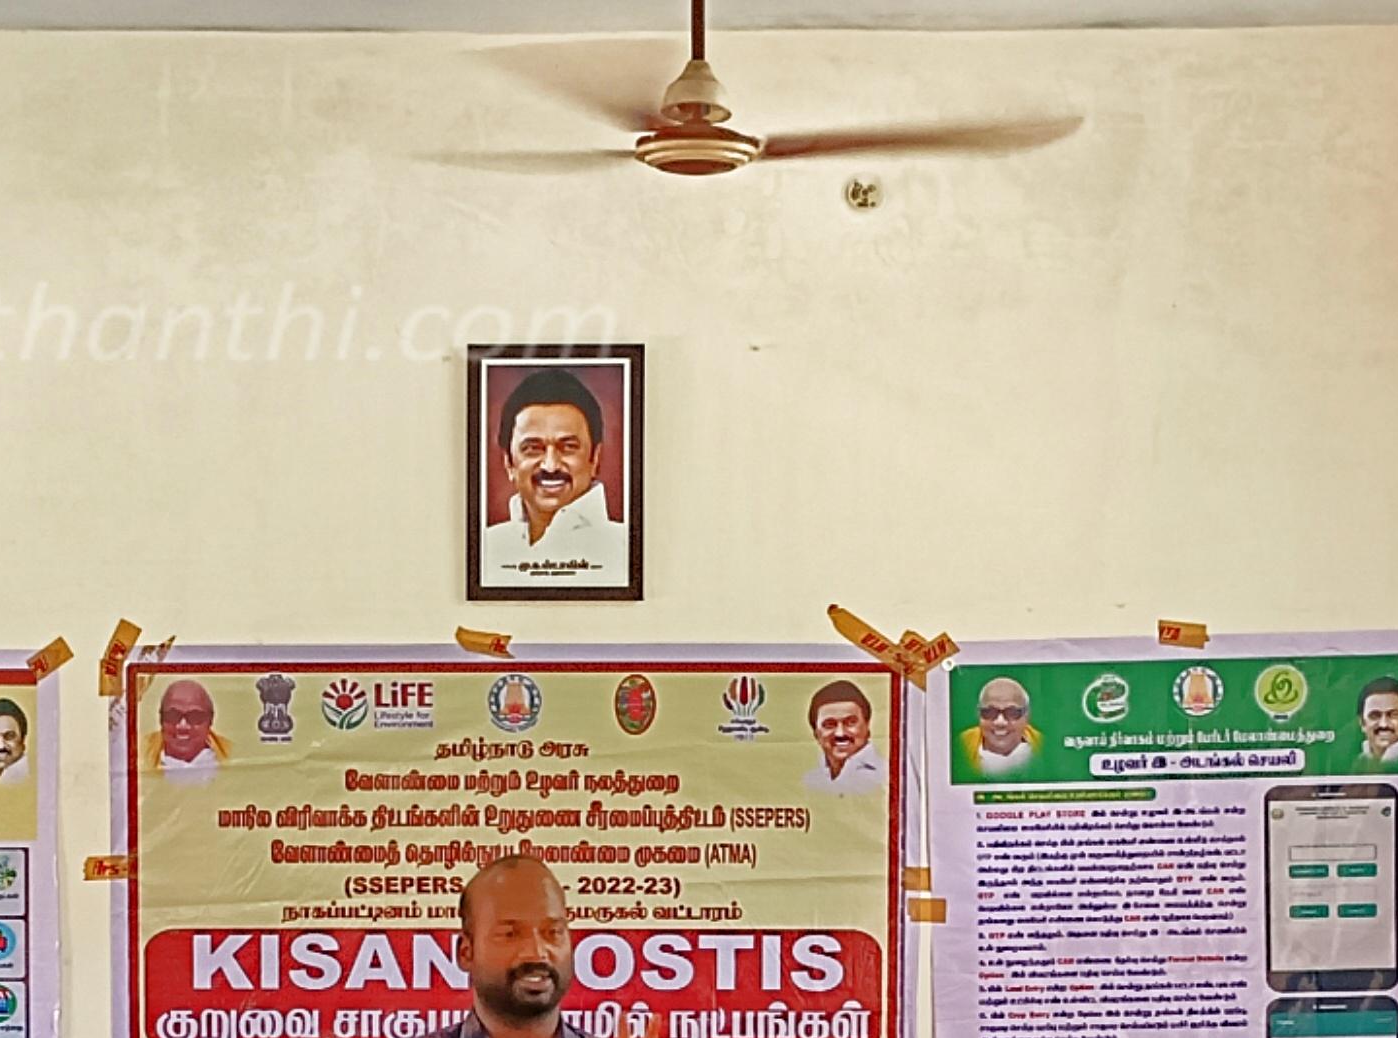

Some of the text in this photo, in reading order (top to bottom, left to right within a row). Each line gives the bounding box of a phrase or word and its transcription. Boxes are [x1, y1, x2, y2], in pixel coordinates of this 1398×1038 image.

[374, 681, 434, 708] LiFE
[434, 739, 589, 761] தமிழ்நாடு அரசு
[345, 769, 681, 798] வேளாண்மை மற்றும் உழவர் நலத்துறை
[217, 803, 273, 830] மாநில
[730, 806, 811, 833] (SSEPERS)
[634, 843, 701, 868] முகமை
[704, 842, 757, 869] (ATMA)
[577, 875, 682, 899] 2022-23)
[281, 899, 422, 923] நாகப்பட்டினம்
[651, 899, 743, 922] வட்டாரம்
[192, 932, 846, 992] KISAN OSTIS
